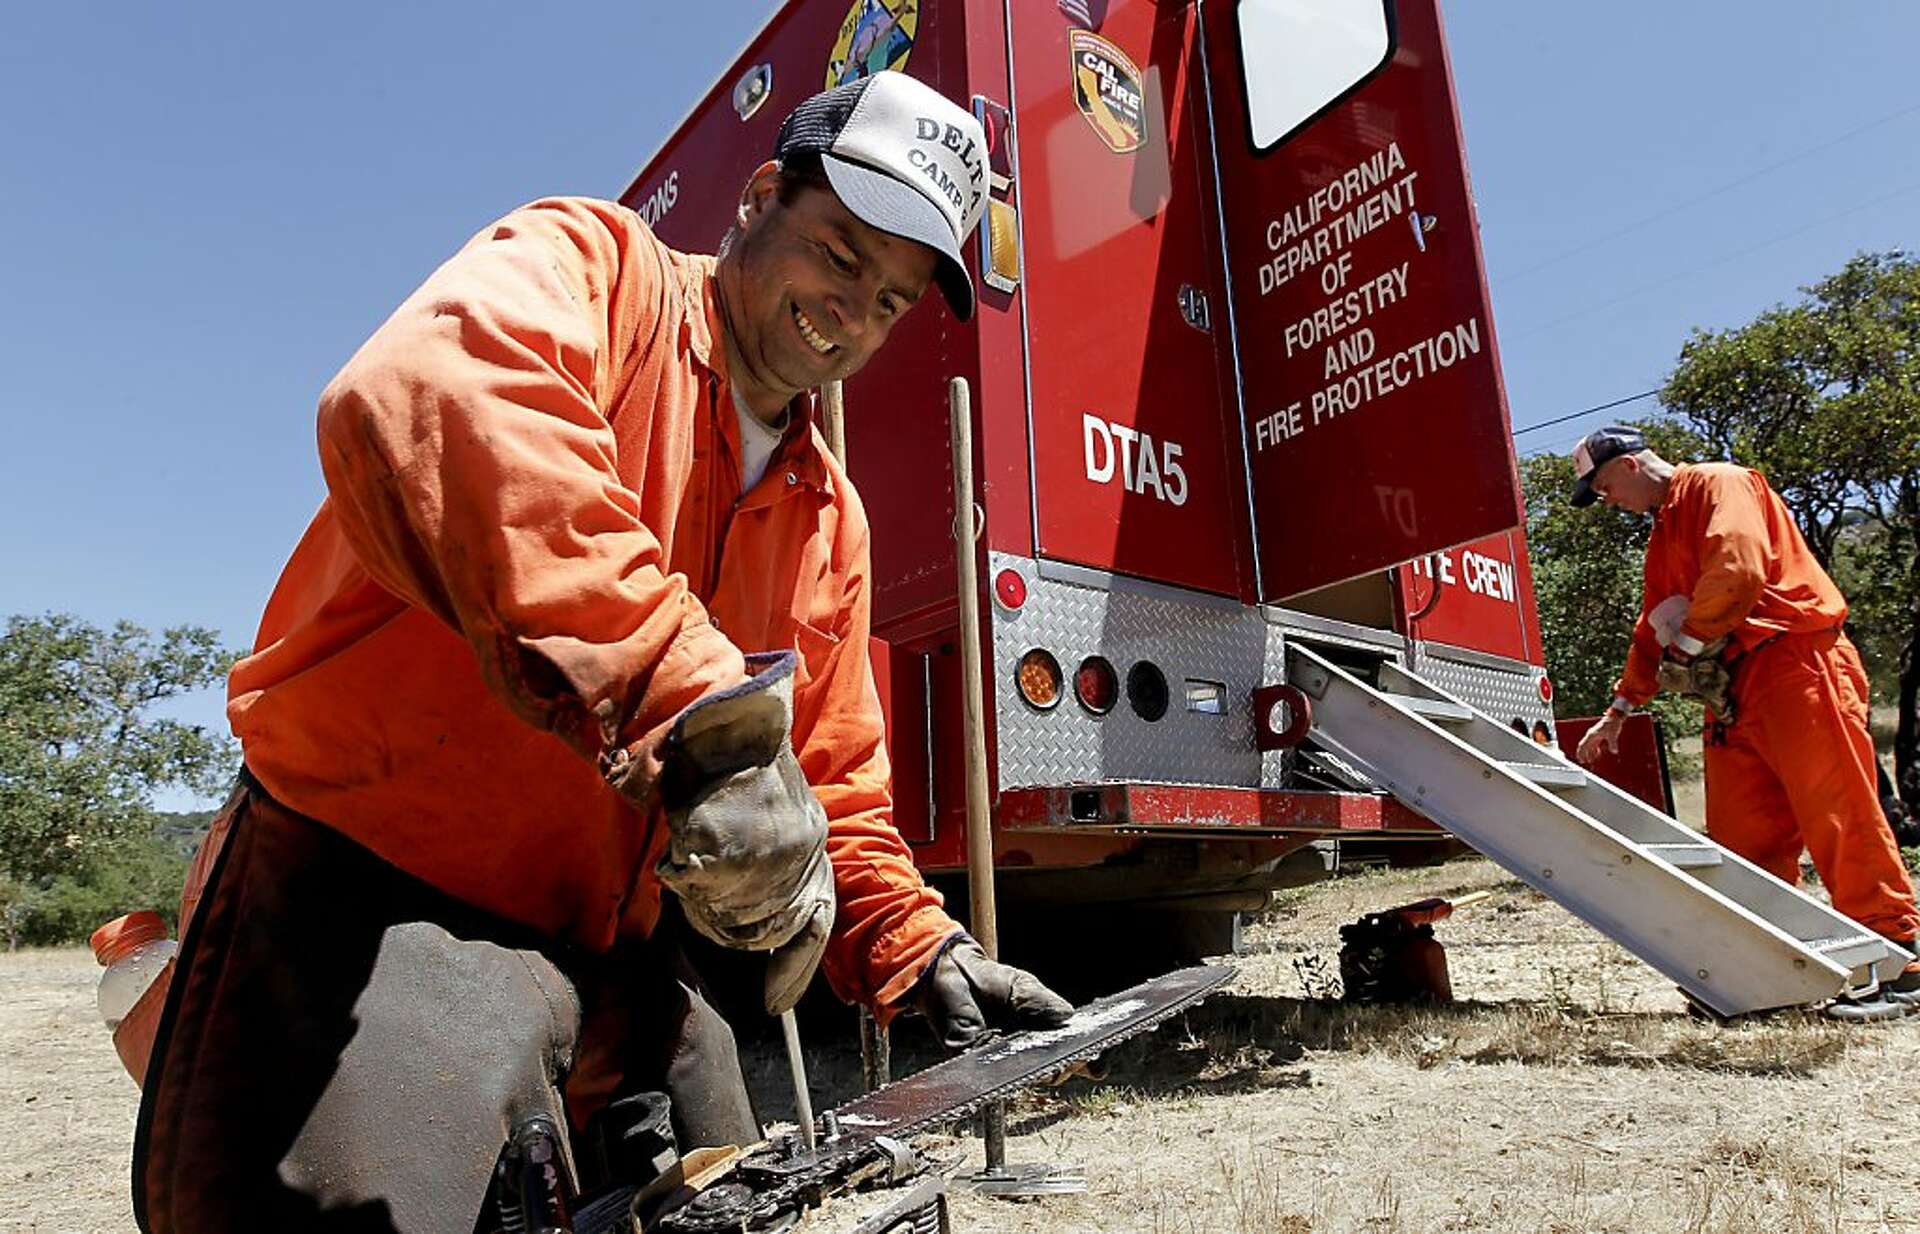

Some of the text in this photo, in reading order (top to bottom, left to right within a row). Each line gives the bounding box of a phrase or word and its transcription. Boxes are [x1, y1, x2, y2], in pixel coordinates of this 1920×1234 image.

[1083, 52, 1118, 82] CAL
[1101, 76, 1140, 110] FIRE
[915, 117, 983, 210] DELTA
[1267, 142, 1405, 250] CALIFORNIA
[1259, 172, 1418, 295] DEPARTMENT
[1321, 251, 1352, 294] OF
[1284, 262, 1409, 358] FORESTRY
[1325, 327, 1375, 380] AND
[1255, 318, 1480, 451] FIRE PROTECTION
[1083, 412, 1188, 506] DTA5
[1462, 551, 1514, 602] CREW
